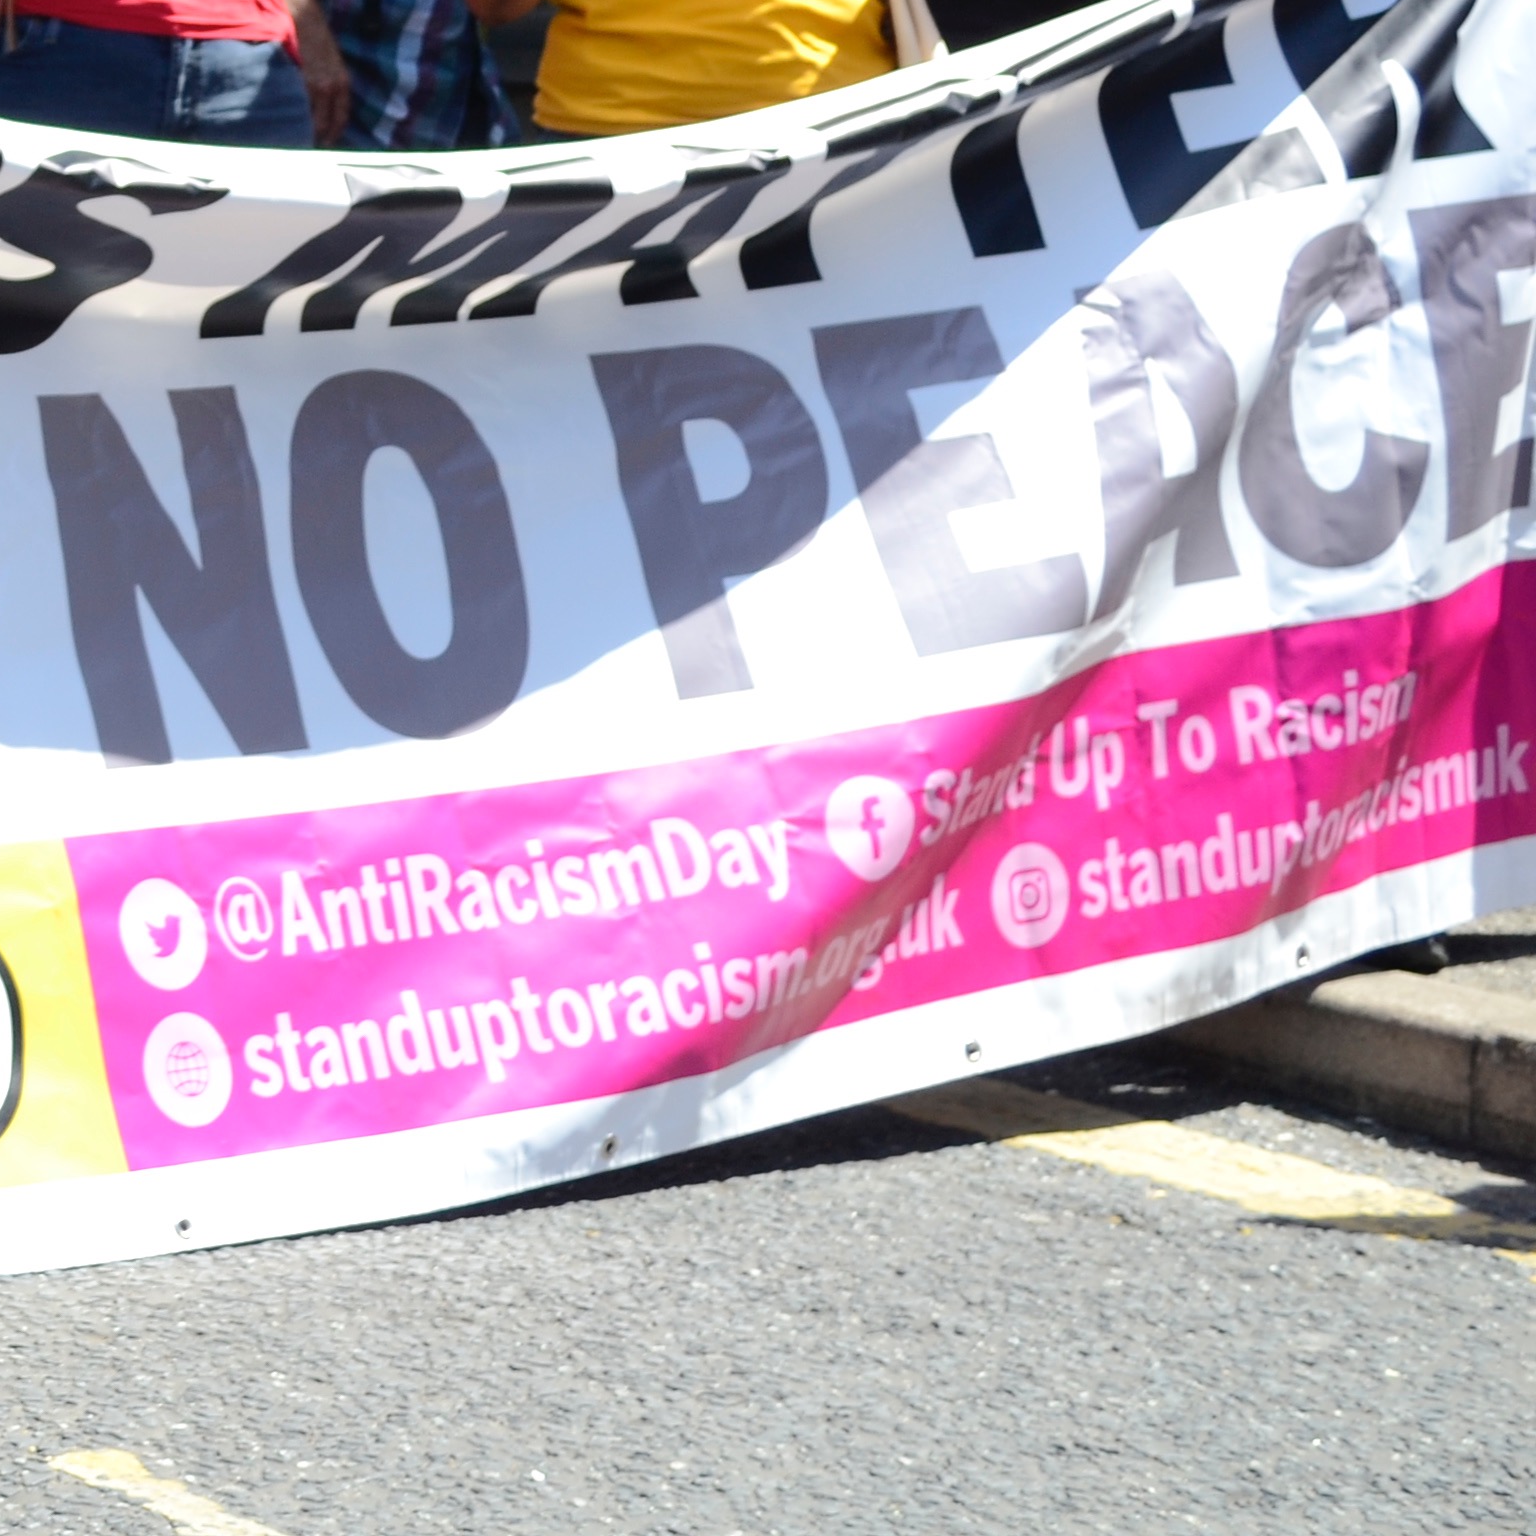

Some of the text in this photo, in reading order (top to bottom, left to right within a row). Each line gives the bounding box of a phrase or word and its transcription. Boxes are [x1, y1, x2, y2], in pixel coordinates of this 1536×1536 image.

[37, 369, 531, 769] NO
[590, 192, 1536, 701] PEACE
[920, 667, 1419, 848] Stand Up To Racism
[1077, 724, 1531, 919] standuptoracismuk
[213, 815, 790, 963] @AntiRacismDay
[244, 880, 965, 1101] standuptoracism.org.uk
